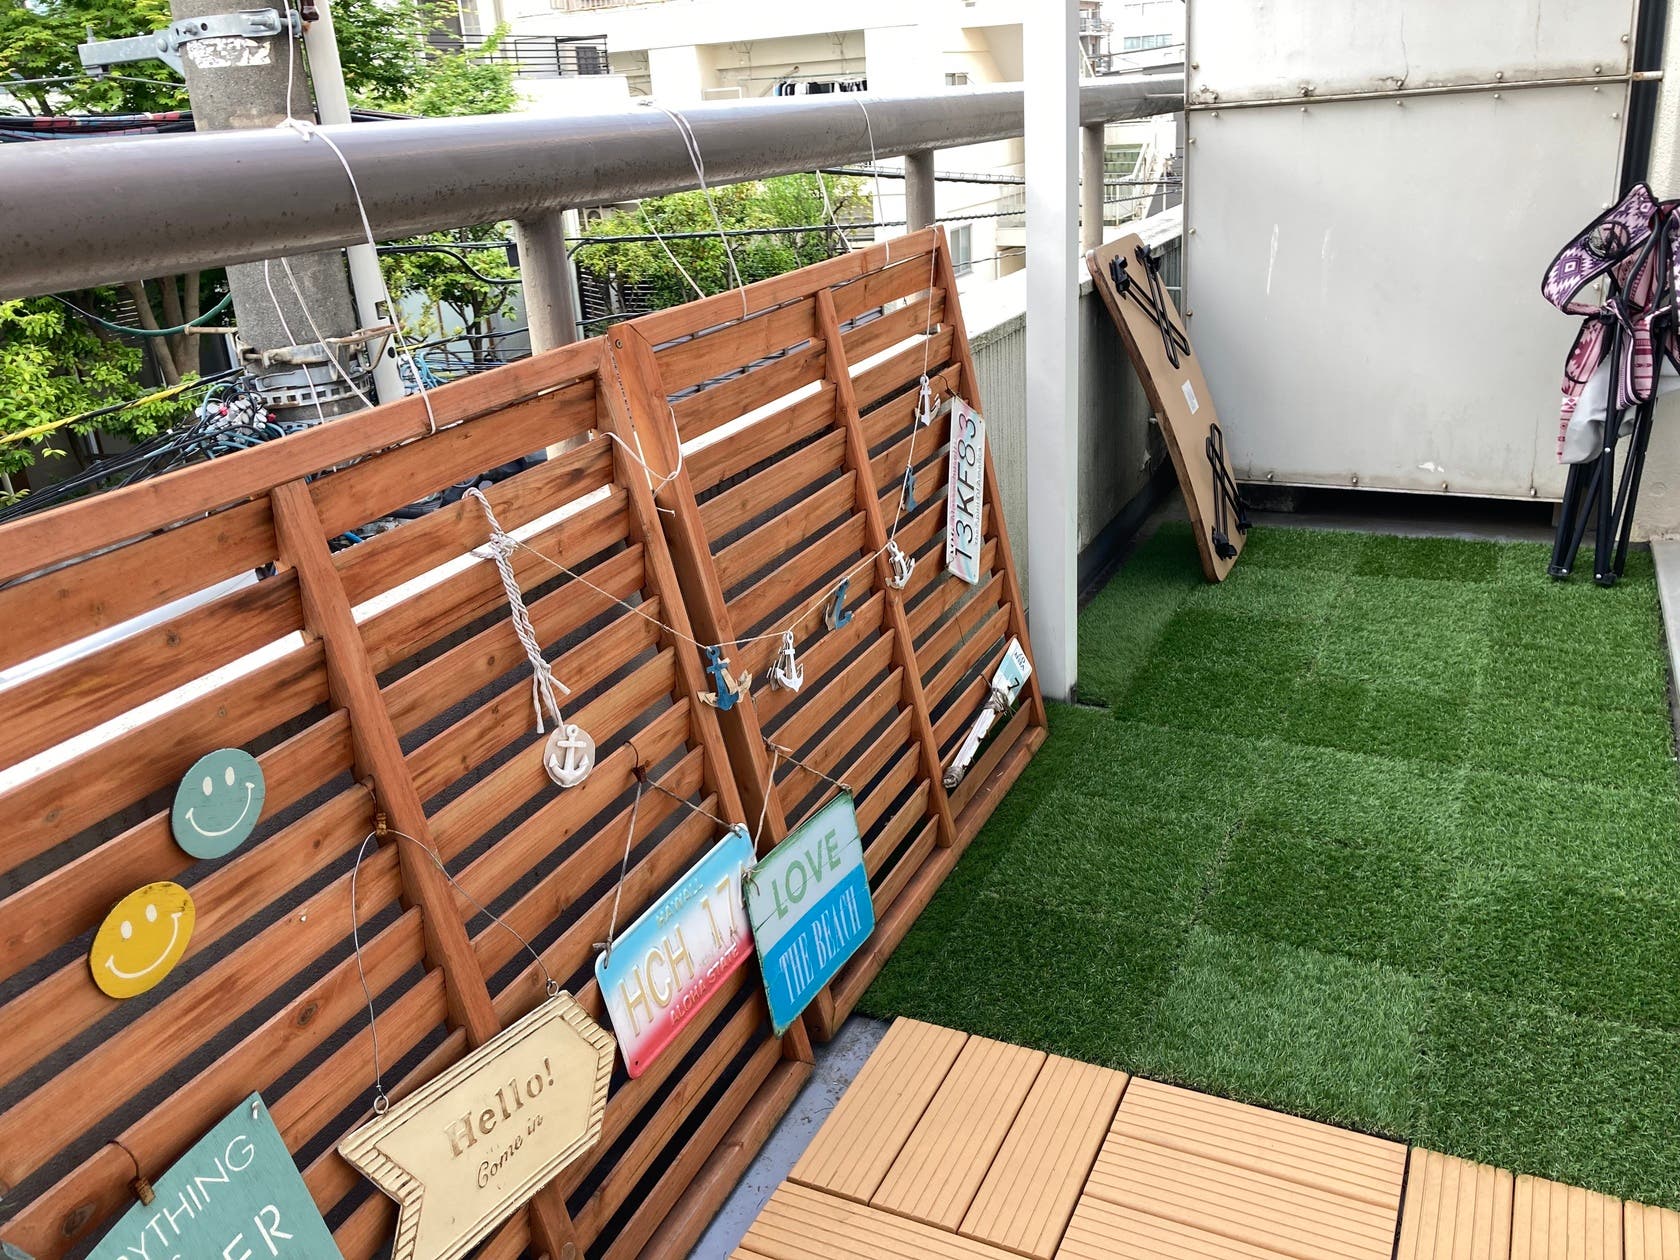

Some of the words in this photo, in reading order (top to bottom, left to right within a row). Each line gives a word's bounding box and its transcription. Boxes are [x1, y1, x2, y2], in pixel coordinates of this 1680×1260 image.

[954, 413, 977, 560] 13KF83
[655, 877, 704, 929] HAWAII
[771, 828, 842, 920] LOVE
[619, 922, 695, 1037] HCH
[669, 979, 707, 1026] ALOHA
[706, 942, 738, 985] STATE
[779, 932, 815, 1005] THE
[811, 885, 863, 970] BEACH
[443, 1056, 555, 1159] Hello!
[477, 1135, 523, 1189] Come
[527, 1113, 544, 1137] in
[116, 1135, 255, 1260] YTHING
